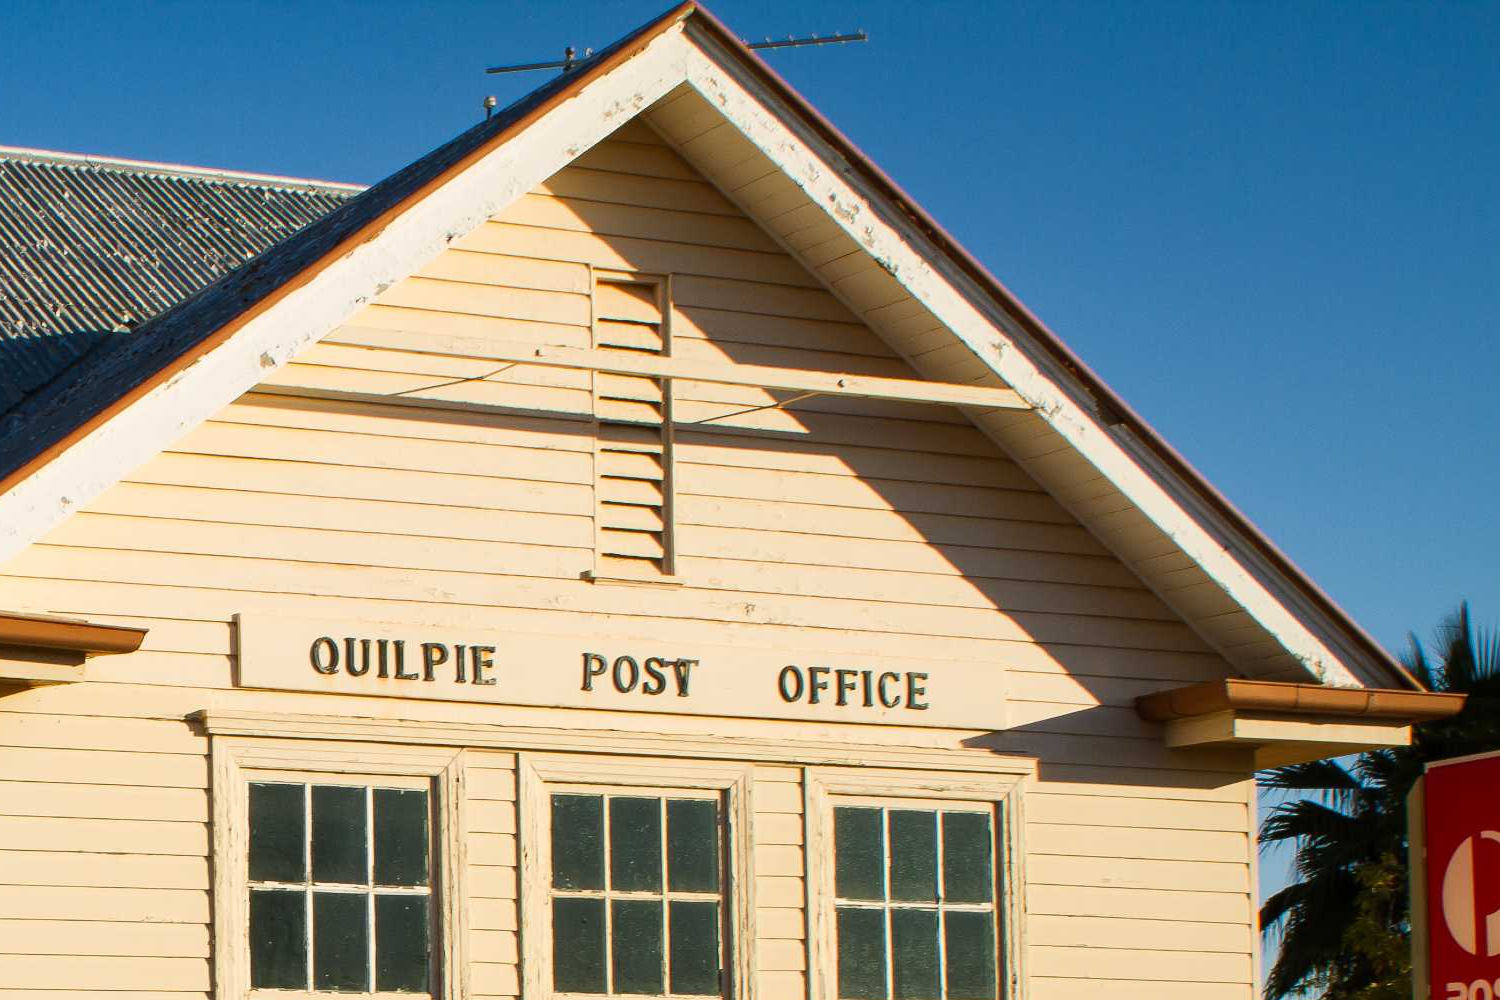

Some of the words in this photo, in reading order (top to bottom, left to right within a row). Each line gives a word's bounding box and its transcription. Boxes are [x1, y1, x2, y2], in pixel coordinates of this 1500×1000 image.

[309, 636, 497, 686] QUILPIE
[580, 652, 700, 698] POST
[777, 665, 930, 710] OFFICE
